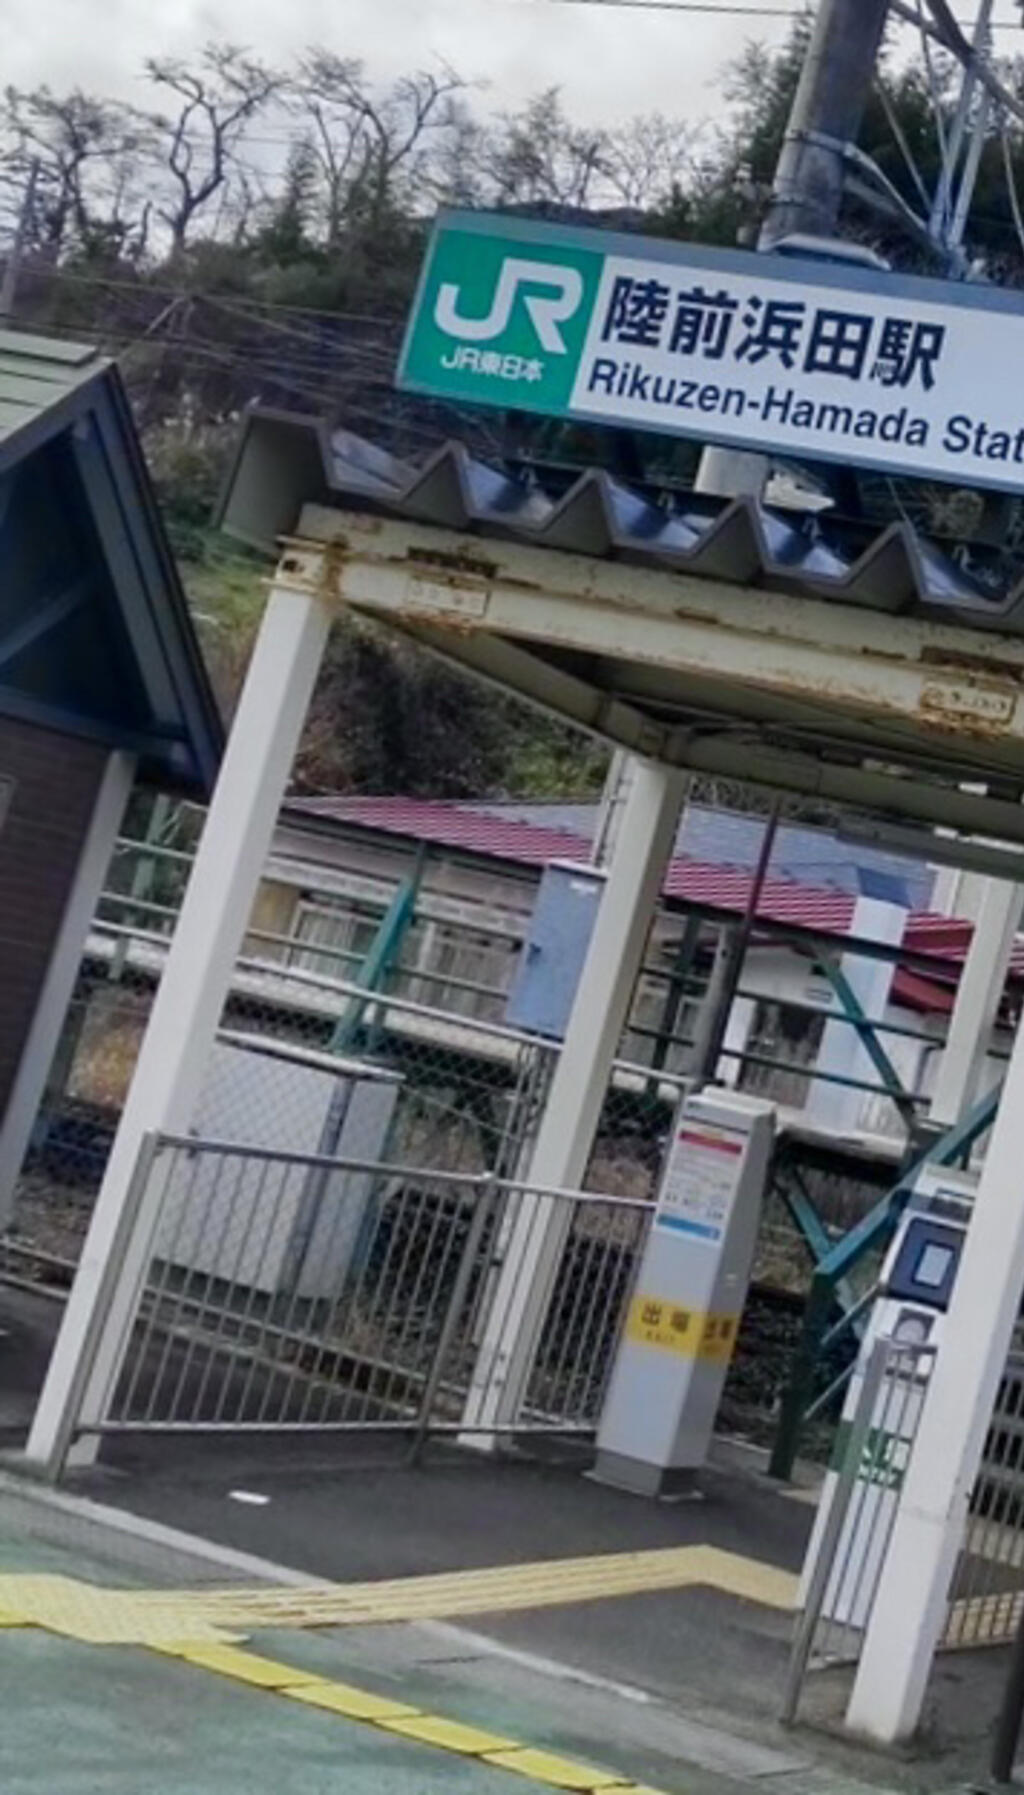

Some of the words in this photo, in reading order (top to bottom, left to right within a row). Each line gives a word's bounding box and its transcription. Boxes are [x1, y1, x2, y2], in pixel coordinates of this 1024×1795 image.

[434, 258, 583, 355] JR
[599, 275, 947, 392] 陸前浜田駅
[587, 358, 930, 447] Rikuzen-Hamada
